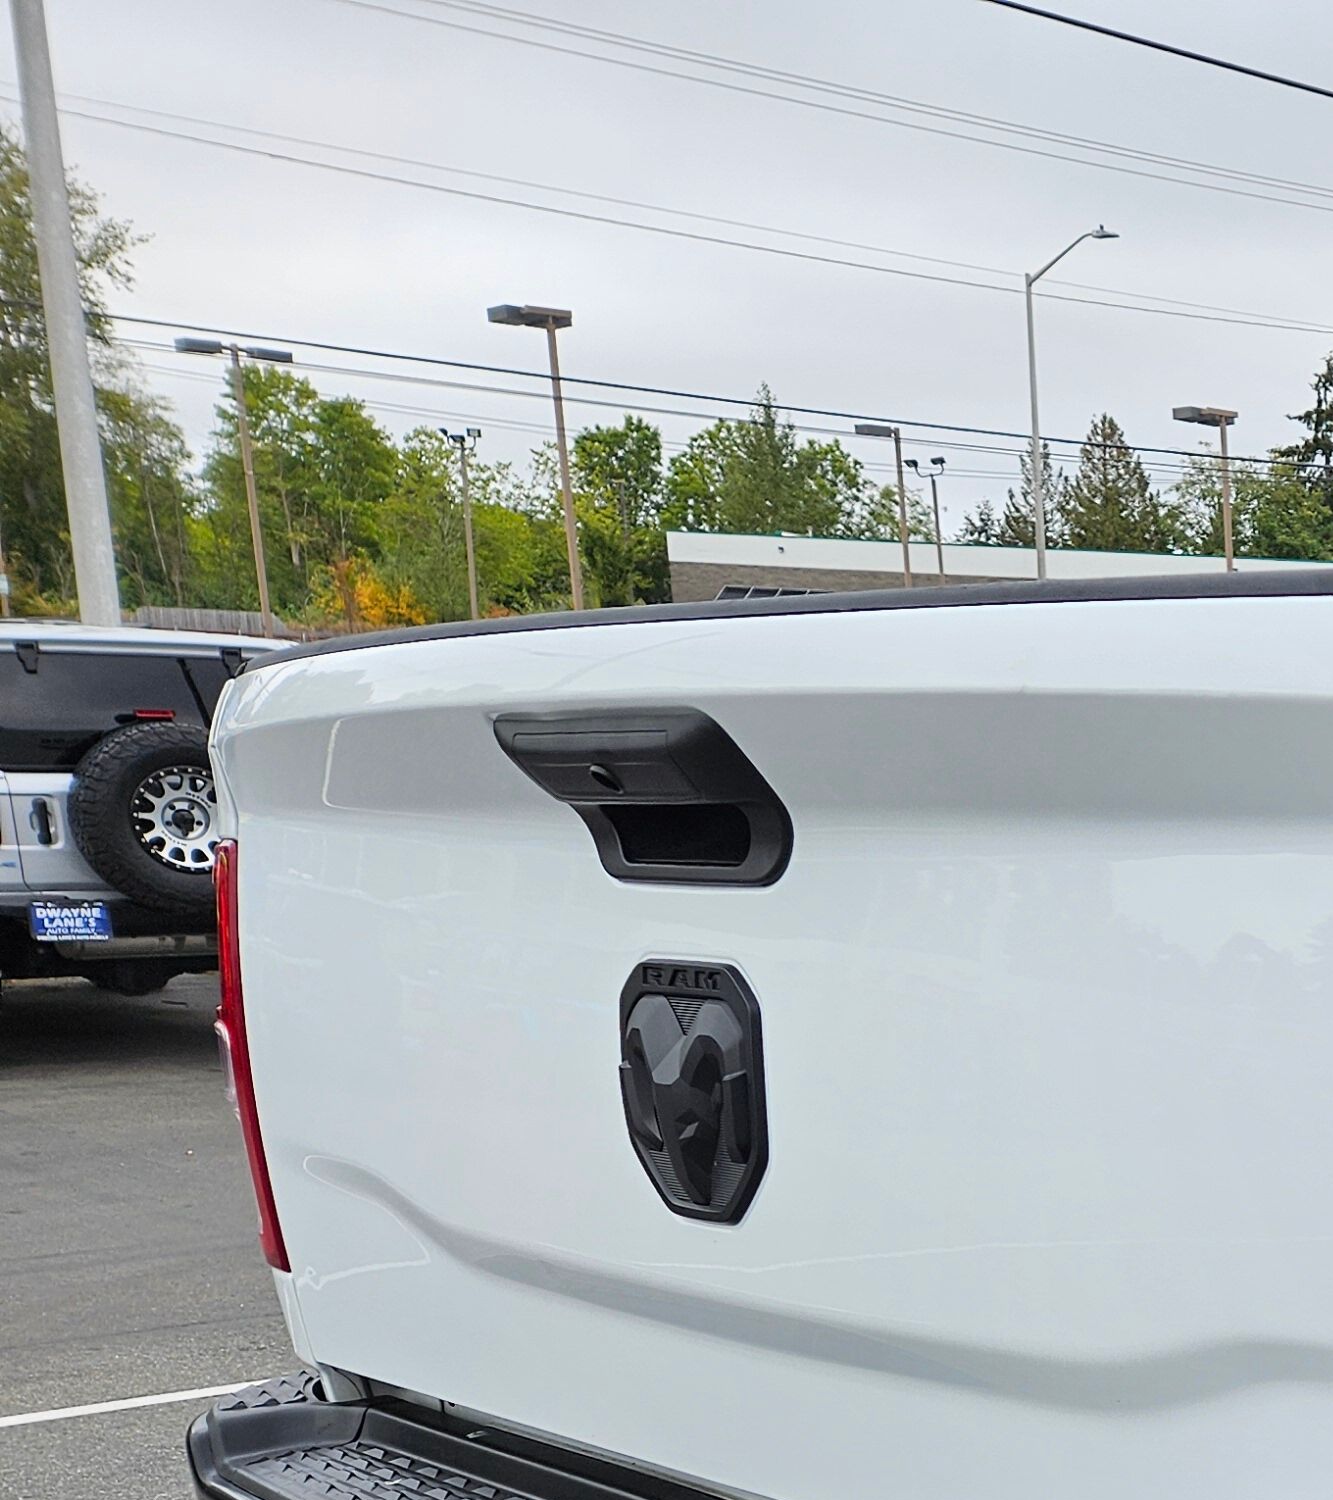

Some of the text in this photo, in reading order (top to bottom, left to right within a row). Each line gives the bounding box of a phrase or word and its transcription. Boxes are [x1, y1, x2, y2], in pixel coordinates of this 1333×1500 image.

[35, 907, 102, 919] DWAYNE
[43, 917, 97, 928] LANE'S
[642, 966, 722, 991] RAM
